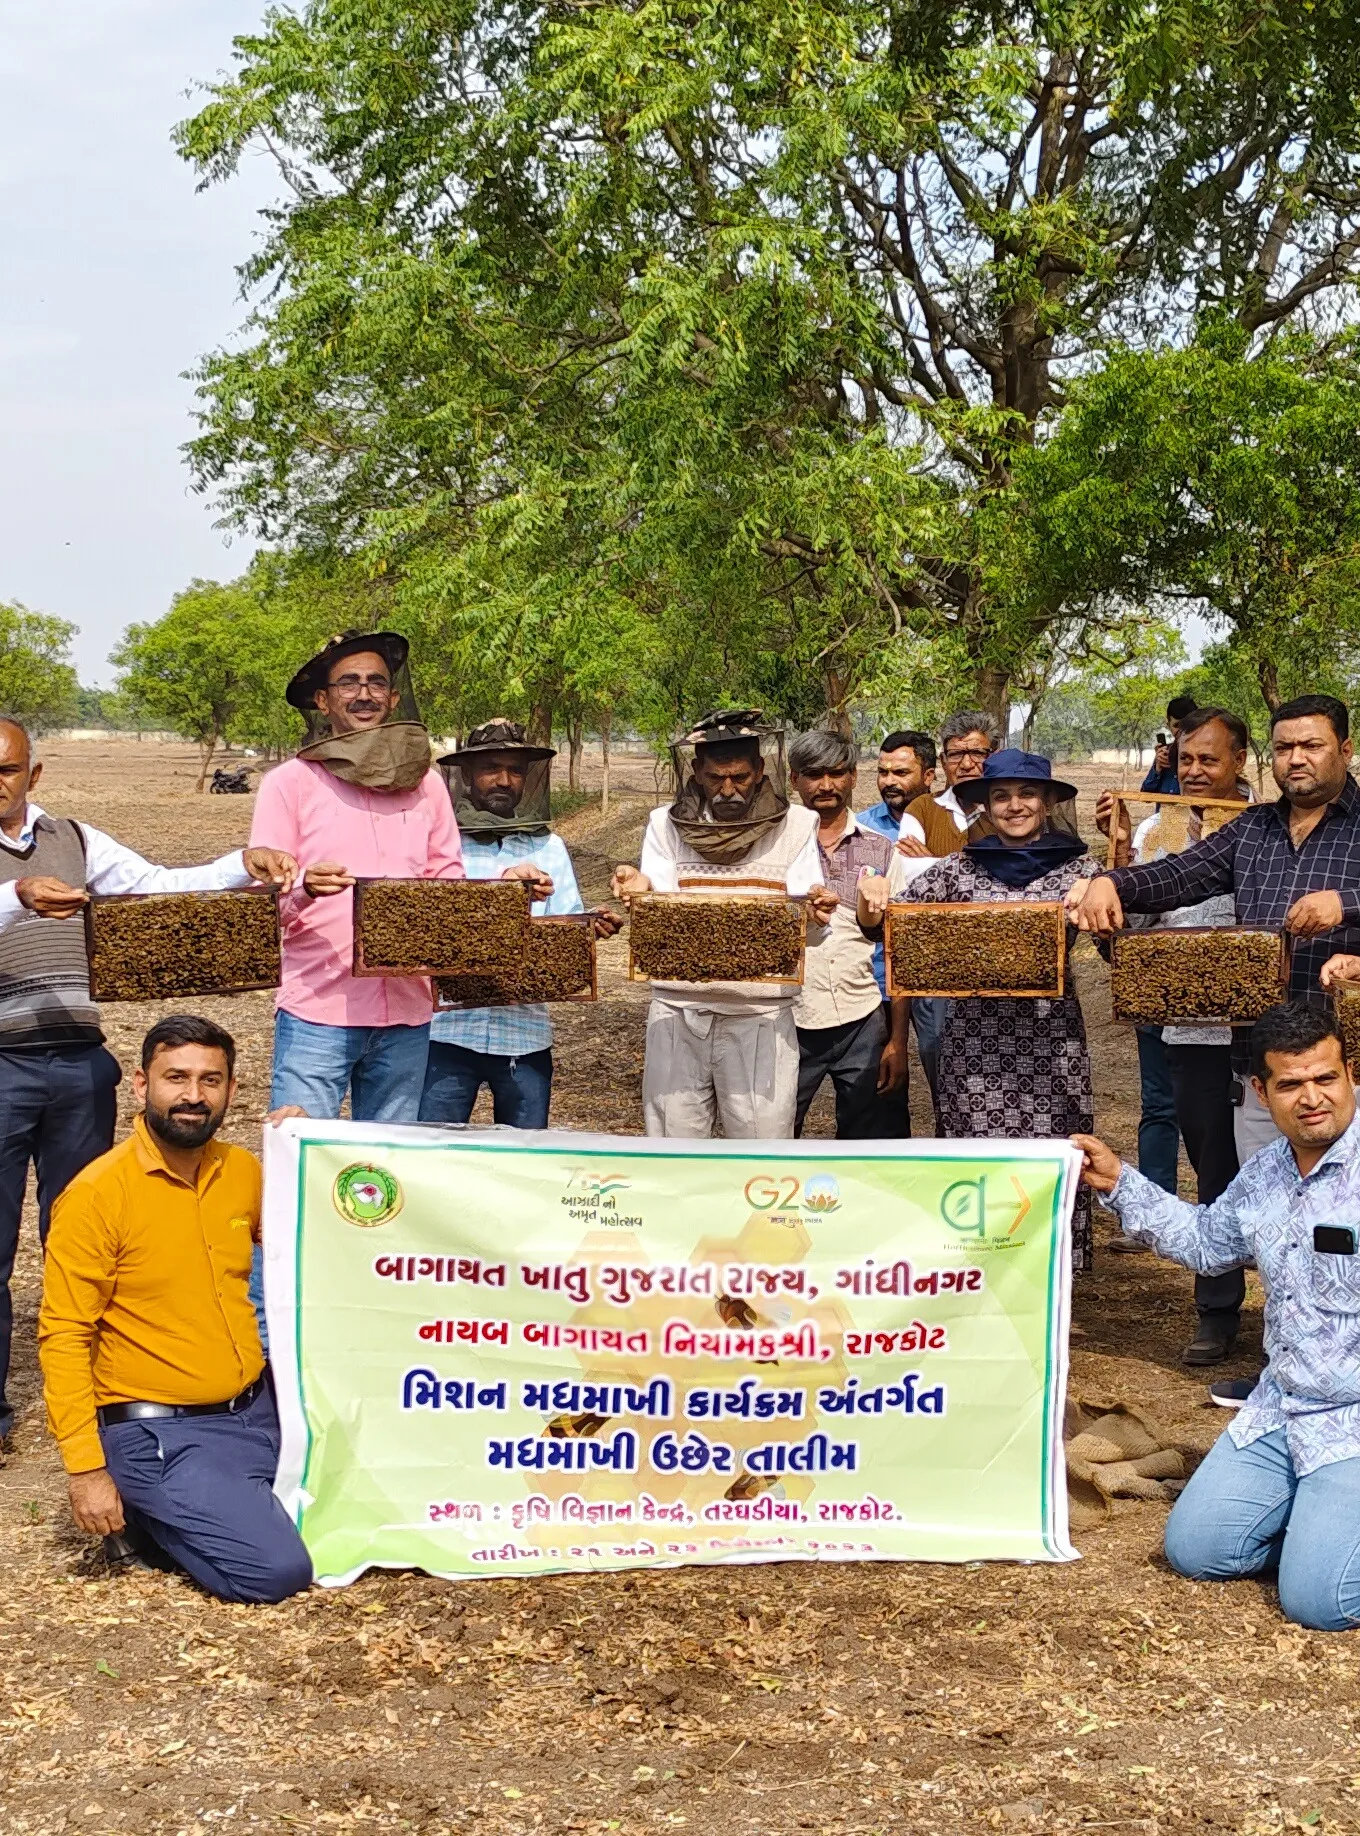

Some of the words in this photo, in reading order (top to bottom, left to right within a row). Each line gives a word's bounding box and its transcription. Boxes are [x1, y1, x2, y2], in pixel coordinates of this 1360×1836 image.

[374, 1255, 506, 1287] બાગાયત
[522, 1265, 591, 1303] ખાતુ
[601, 1266, 712, 1304] ગુજરાત
[835, 1258, 983, 1296] ગાંધીનગર
[418, 1320, 508, 1345] નાયબ
[523, 1323, 647, 1353] બાગાયત
[664, 1322, 832, 1361] નિયામકશ્રી,
[846, 1321, 946, 1355] રાજકોટ
[403, 1368, 507, 1409] મિશન
[524, 1380, 670, 1416] મધમાખી
[687, 1380, 803, 1418] કાર્યક્રમ
[819, 1374, 944, 1416] અંતર્ગત
[488, 1431, 635, 1469] મધમાખી
[652, 1434, 732, 1471] ઉછેર
[745, 1434, 857, 1471] તાલીમ
[429, 1502, 482, 1521] સ્થળ
[511, 1496, 551, 1529] કૃષિ
[562, 1496, 632, 1524] વિજ્ઞાન
[642, 1496, 694, 1525] કેન્દ્ર,
[704, 1496, 809, 1523] તરઘડીયા,
[819, 1496, 903, 1522] રાજકોટ.
[471, 1543, 540, 1561] તારીખ
[612, 1542, 655, 1557] અને
